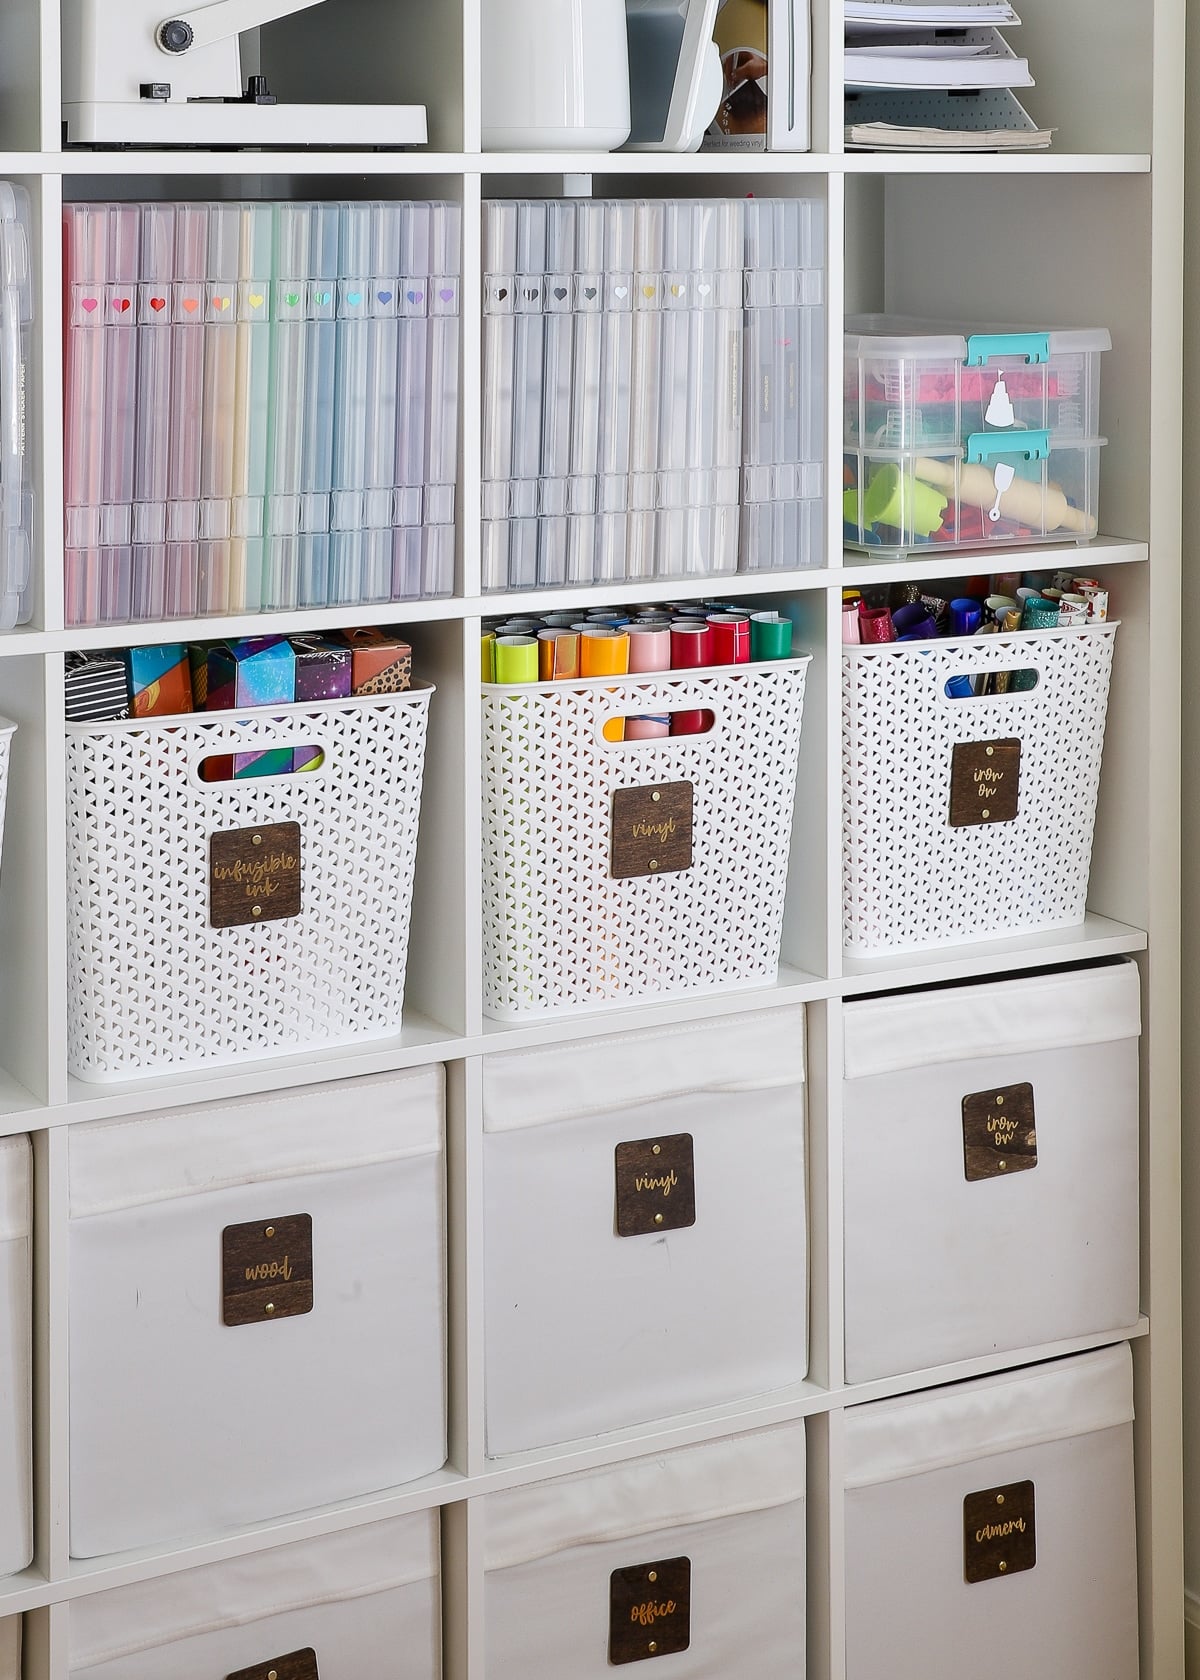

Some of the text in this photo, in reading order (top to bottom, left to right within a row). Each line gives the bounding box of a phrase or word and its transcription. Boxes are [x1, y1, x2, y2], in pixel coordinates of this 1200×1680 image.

[973, 767, 1004, 782] iron
[978, 783, 997, 798] on
[632, 816, 676, 843] vinyl
[213, 851, 297, 884] infusible
[245, 876, 280, 897] ink
[986, 1113, 1019, 1132] iron
[994, 1131, 1014, 1146] on
[635, 1169, 678, 1197] vinyl
[244, 1255, 293, 1281] wood
[975, 1516, 1027, 1543] camera
[630, 1600, 677, 1626] office
